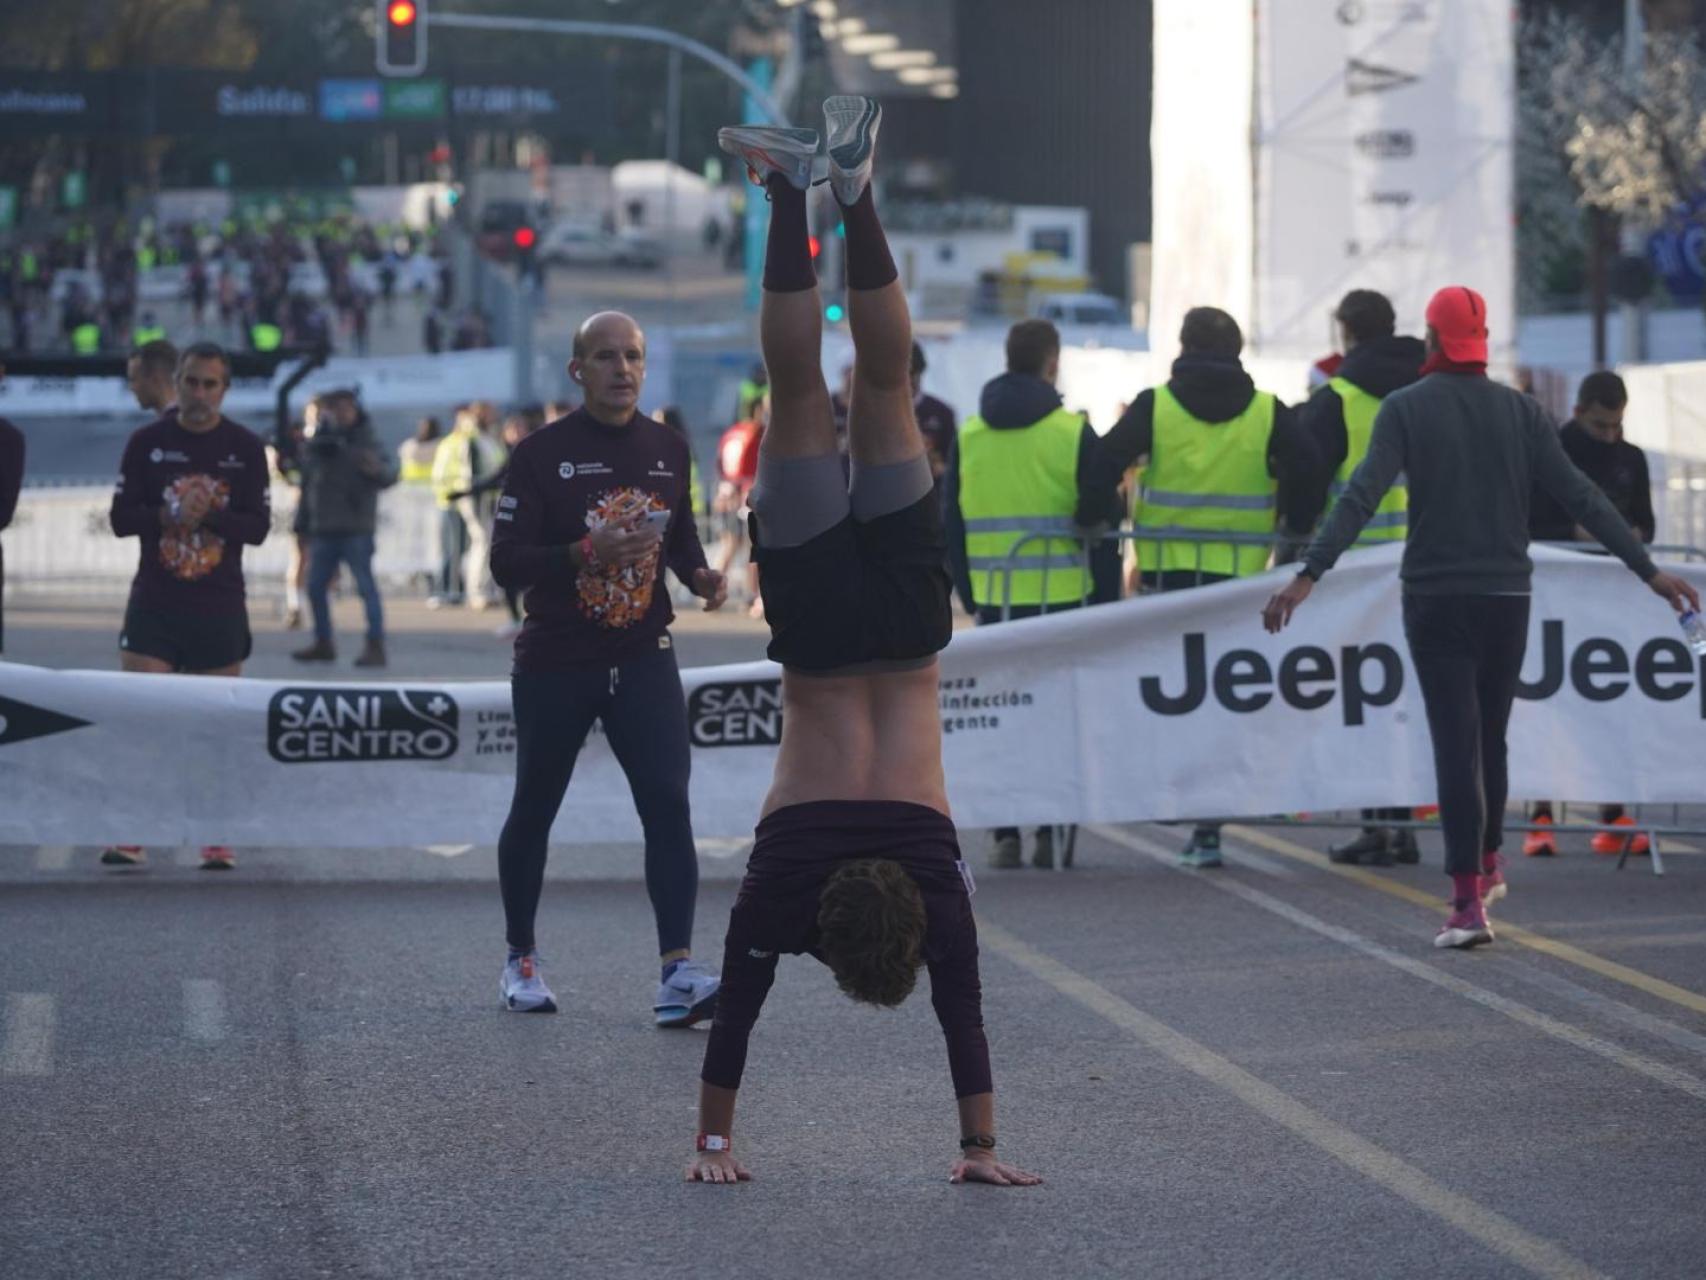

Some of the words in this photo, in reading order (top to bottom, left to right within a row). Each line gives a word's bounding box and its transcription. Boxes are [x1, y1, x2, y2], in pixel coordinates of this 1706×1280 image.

[1139, 632, 1404, 727] Jeep
[1513, 619, 1706, 719] Jee
[279, 694, 382, 729] SANI
[700, 684, 783, 715] SAN
[942, 692, 1033, 710] infección
[694, 708, 783, 742] CEN
[943, 715, 999, 734] gente
[277, 728, 451, 759] CENTRO
